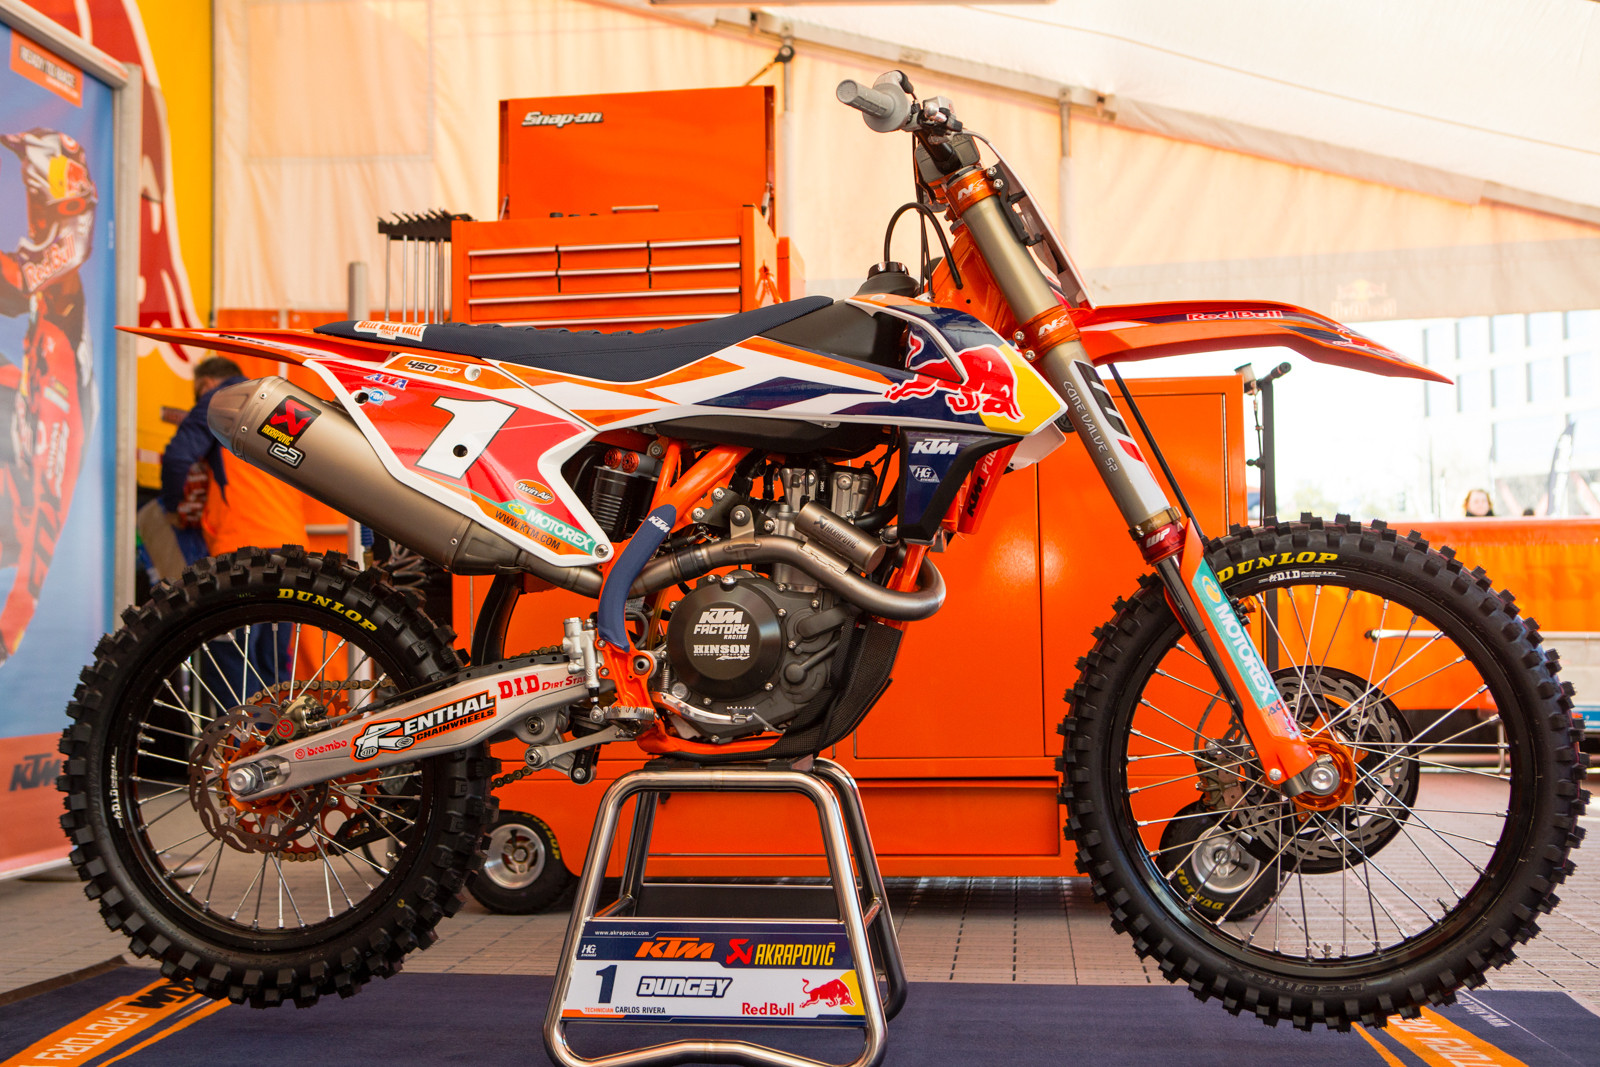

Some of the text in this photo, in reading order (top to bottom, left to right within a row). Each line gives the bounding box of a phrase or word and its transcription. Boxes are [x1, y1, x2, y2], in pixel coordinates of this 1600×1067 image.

[521, 110, 604, 128] Snap-on
[1186, 310, 1284, 321] Red Bull
[406, 360, 438, 372] 450
[364, 373, 408, 390] AMA
[414, 396, 519, 480] 1
[1081, 411, 1108, 453] VALVE
[911, 438, 959, 455] KTM
[517, 482, 552, 501] Twin Air
[967, 476, 985, 517] KTM
[495, 510, 561, 550] WWW.KTM.COM
[525, 509, 595, 551] MOTOREX
[648, 515, 671, 533] KTM
[1216, 551, 1338, 583] DUNLOP
[277, 588, 378, 631] DUNLOP
[698, 608, 743, 624] KTM
[693, 624, 750, 635] FACTORY
[693, 644, 750, 654] HINSON
[1215, 604, 1275, 702] MOTOREX
[498, 675, 540, 699] D.I.D
[416, 709, 495, 740] CHAINWHEELS
[306, 740, 348, 757] brembo
[8, 753, 62, 792] KTM
[582, 944, 596, 953] HG
[634, 937, 715, 959] KTM
[596, 965, 733, 1004] 1 DUNGEY
[742, 1002, 794, 1016] Red Bull
